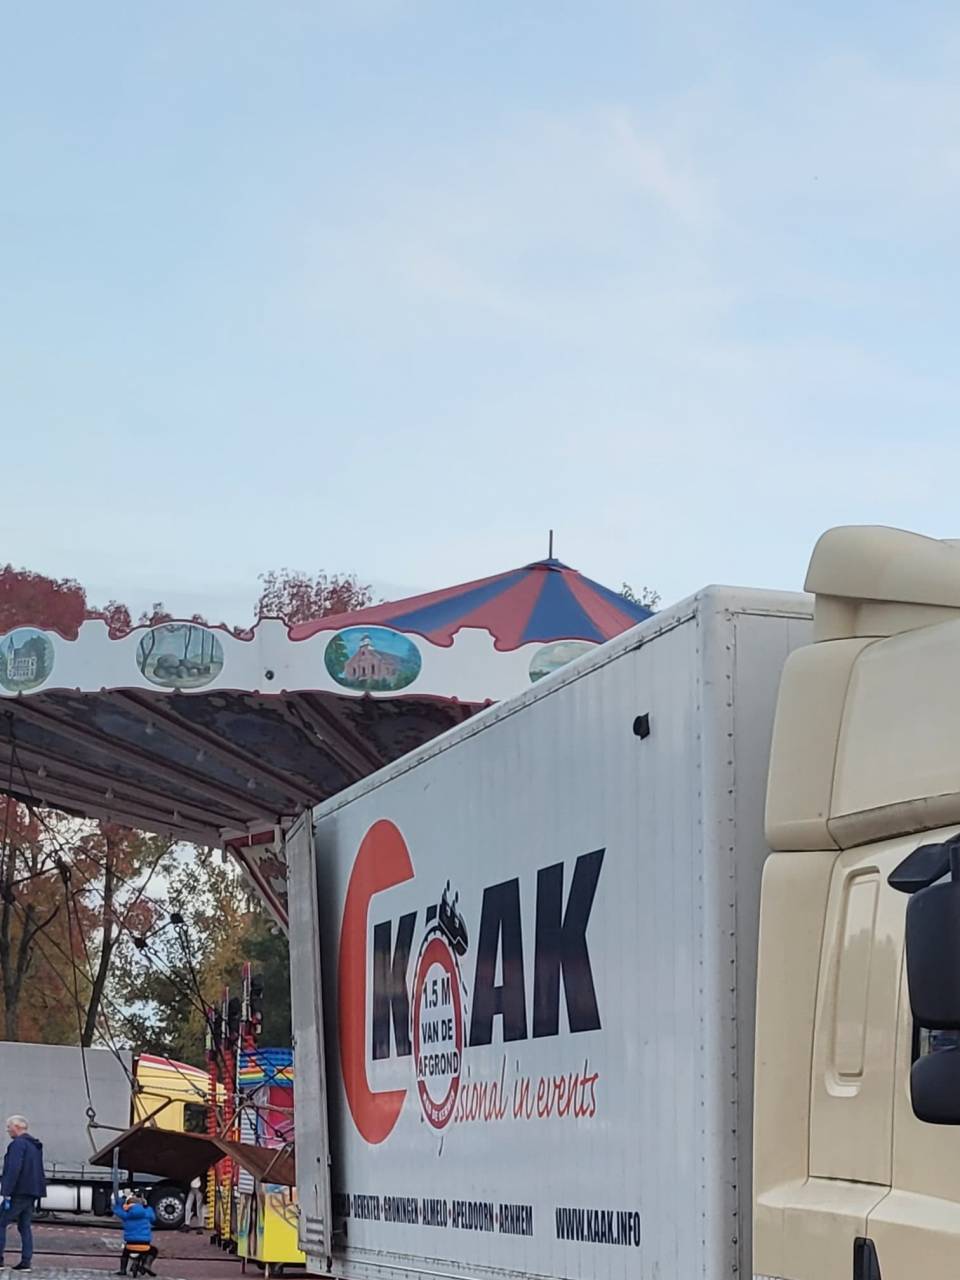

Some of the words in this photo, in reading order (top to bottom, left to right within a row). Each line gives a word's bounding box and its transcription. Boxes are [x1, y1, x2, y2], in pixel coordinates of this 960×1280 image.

[372, 847, 607, 1061] KAK
[441, 977, 451, 1006] M
[421, 1020, 439, 1044] VAN
[441, 1018, 453, 1041] DE
[418, 1051, 459, 1077] AFGROND
[513, 1060, 535, 1120] in
[536, 1058, 599, 1120] events
[354, 1194, 381, 1221] DEVENTER
[383, 1196, 419, 1224] GRONINGEN
[422, 1199, 448, 1228] ALMELO
[452, 1200, 494, 1232] APELDOORN
[499, 1203, 534, 1237] ARNHEM
[555, 1207, 641, 1248] WWW.KAAK.INFO
